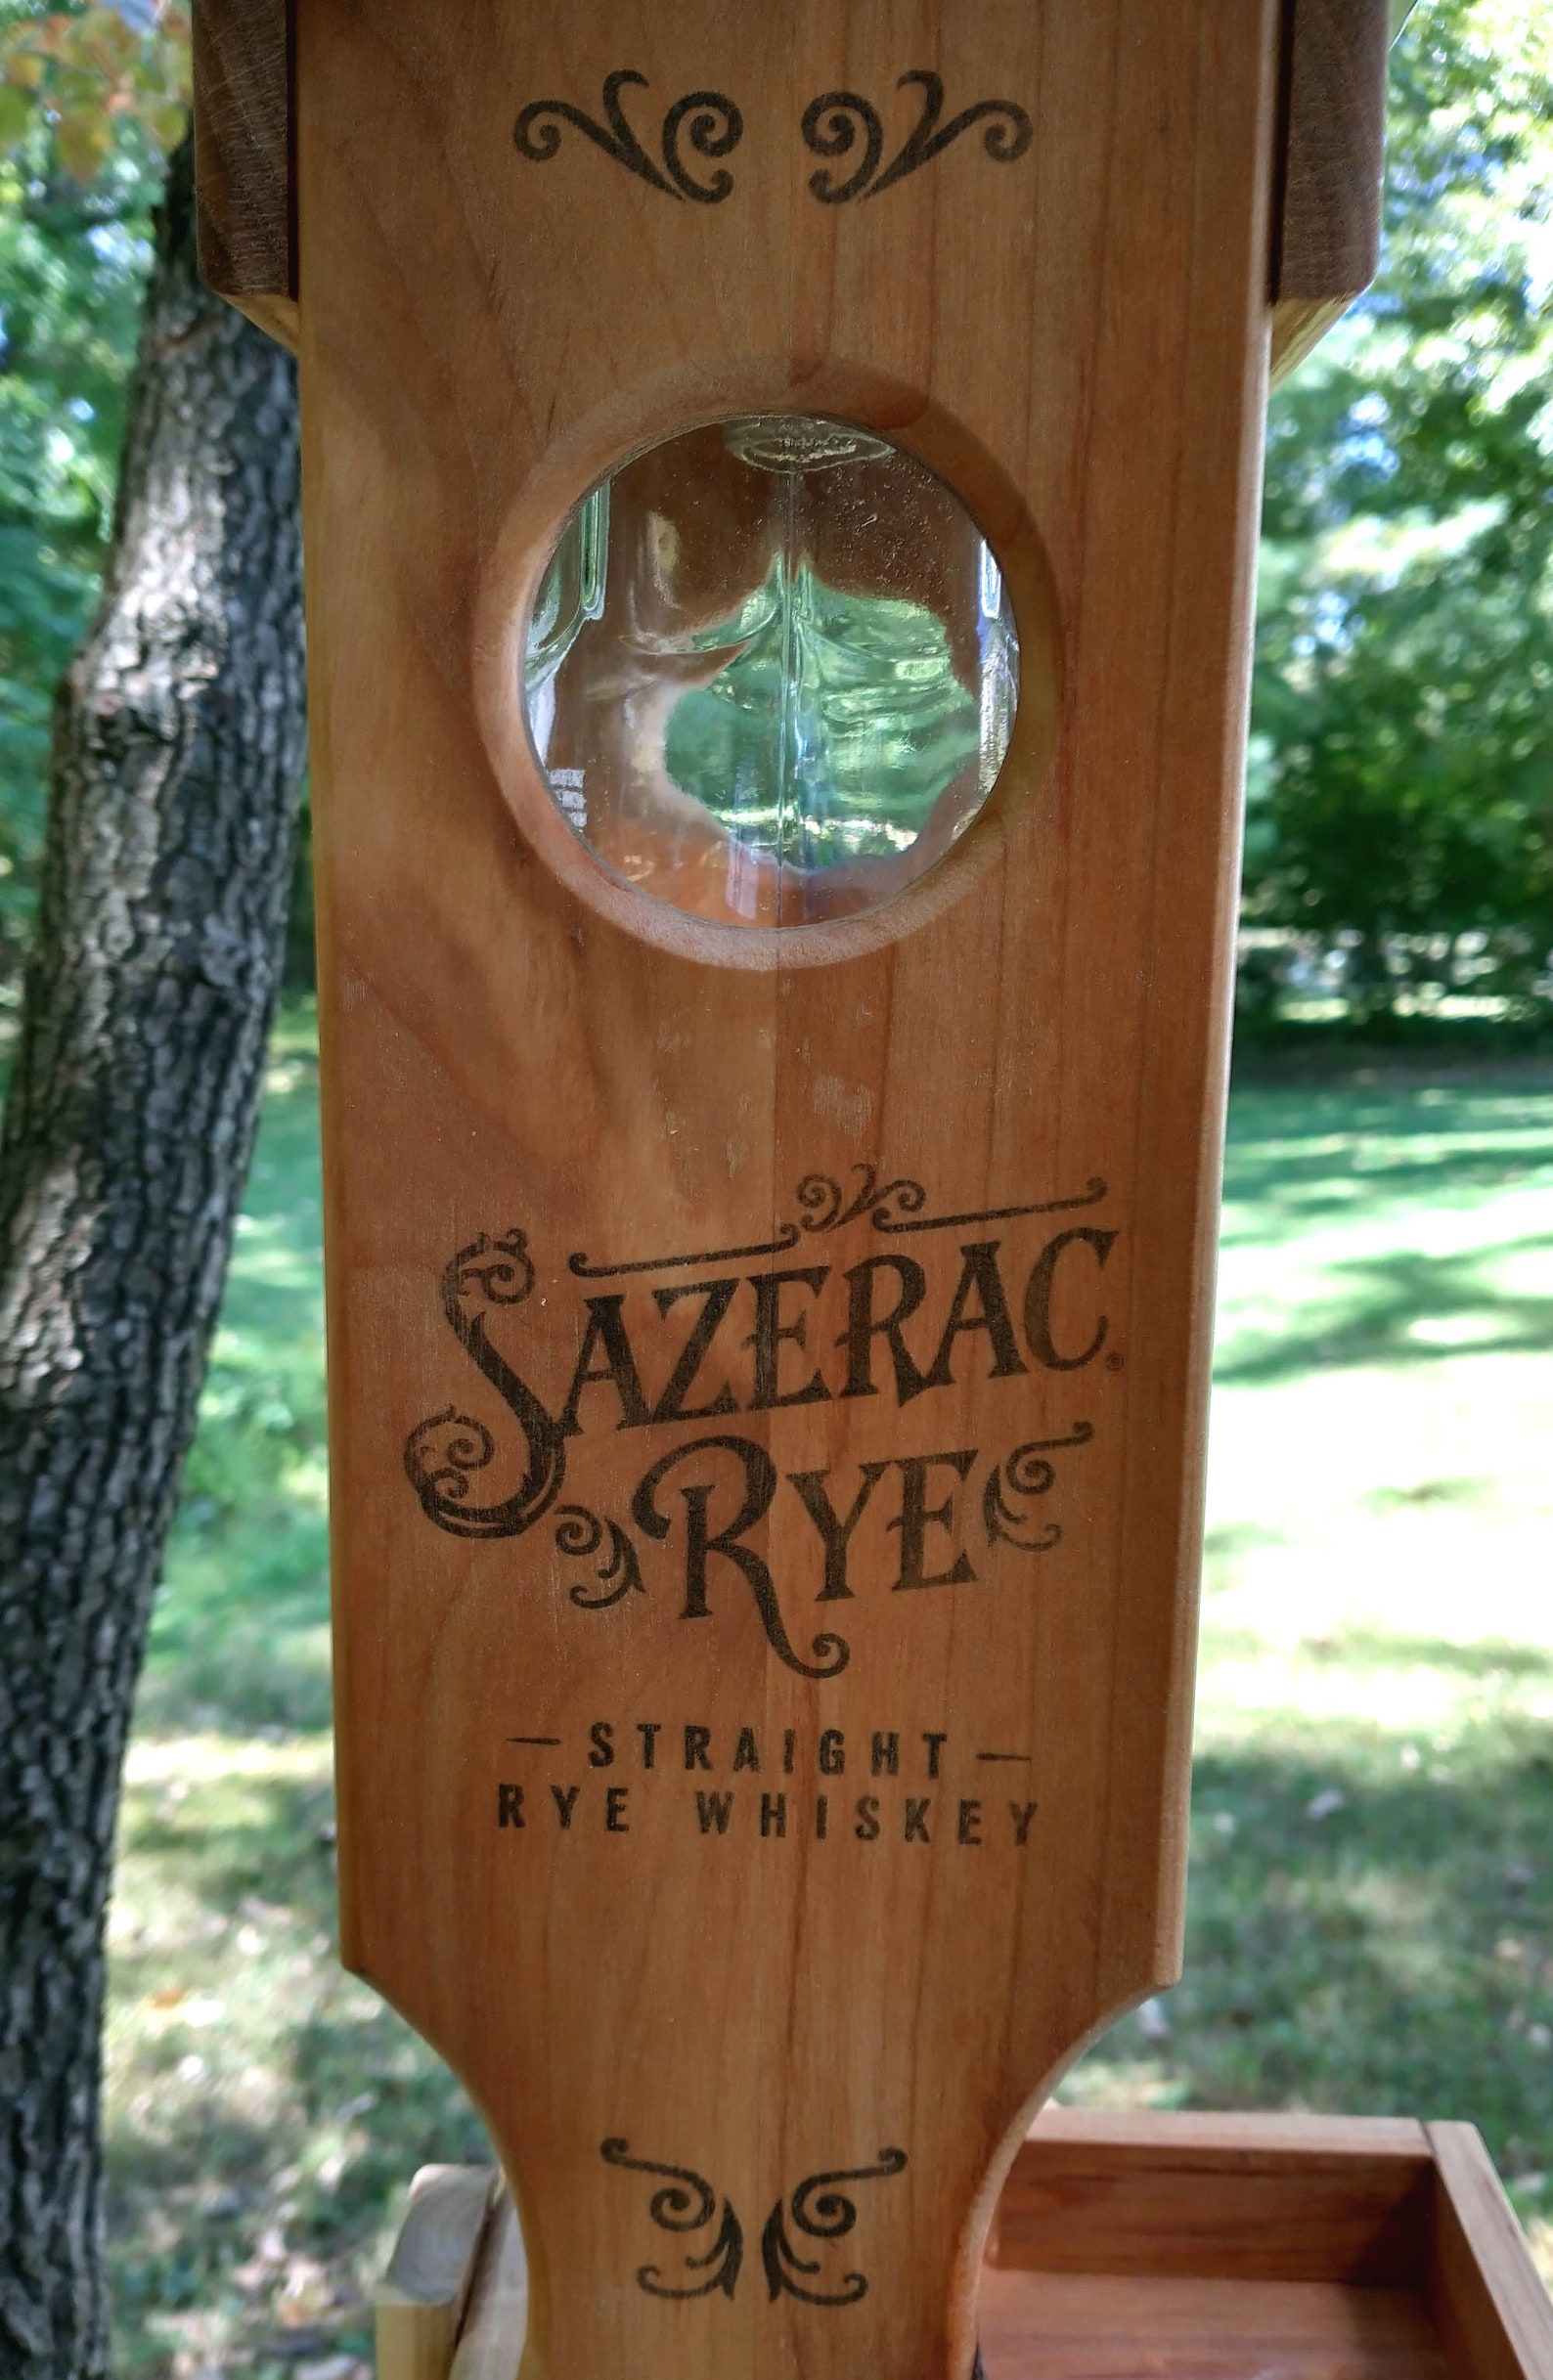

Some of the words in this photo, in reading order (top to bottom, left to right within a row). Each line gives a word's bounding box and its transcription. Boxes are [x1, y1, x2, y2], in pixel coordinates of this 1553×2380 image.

[404, 1228, 1119, 1539] SAZERAC
[632, 1434, 979, 1680] RYE
[498, 1784, 630, 1832] RYE
[695, 1790, 1039, 1846] WHISKEY
[589, 1722, 948, 1781] STRAIGHT
